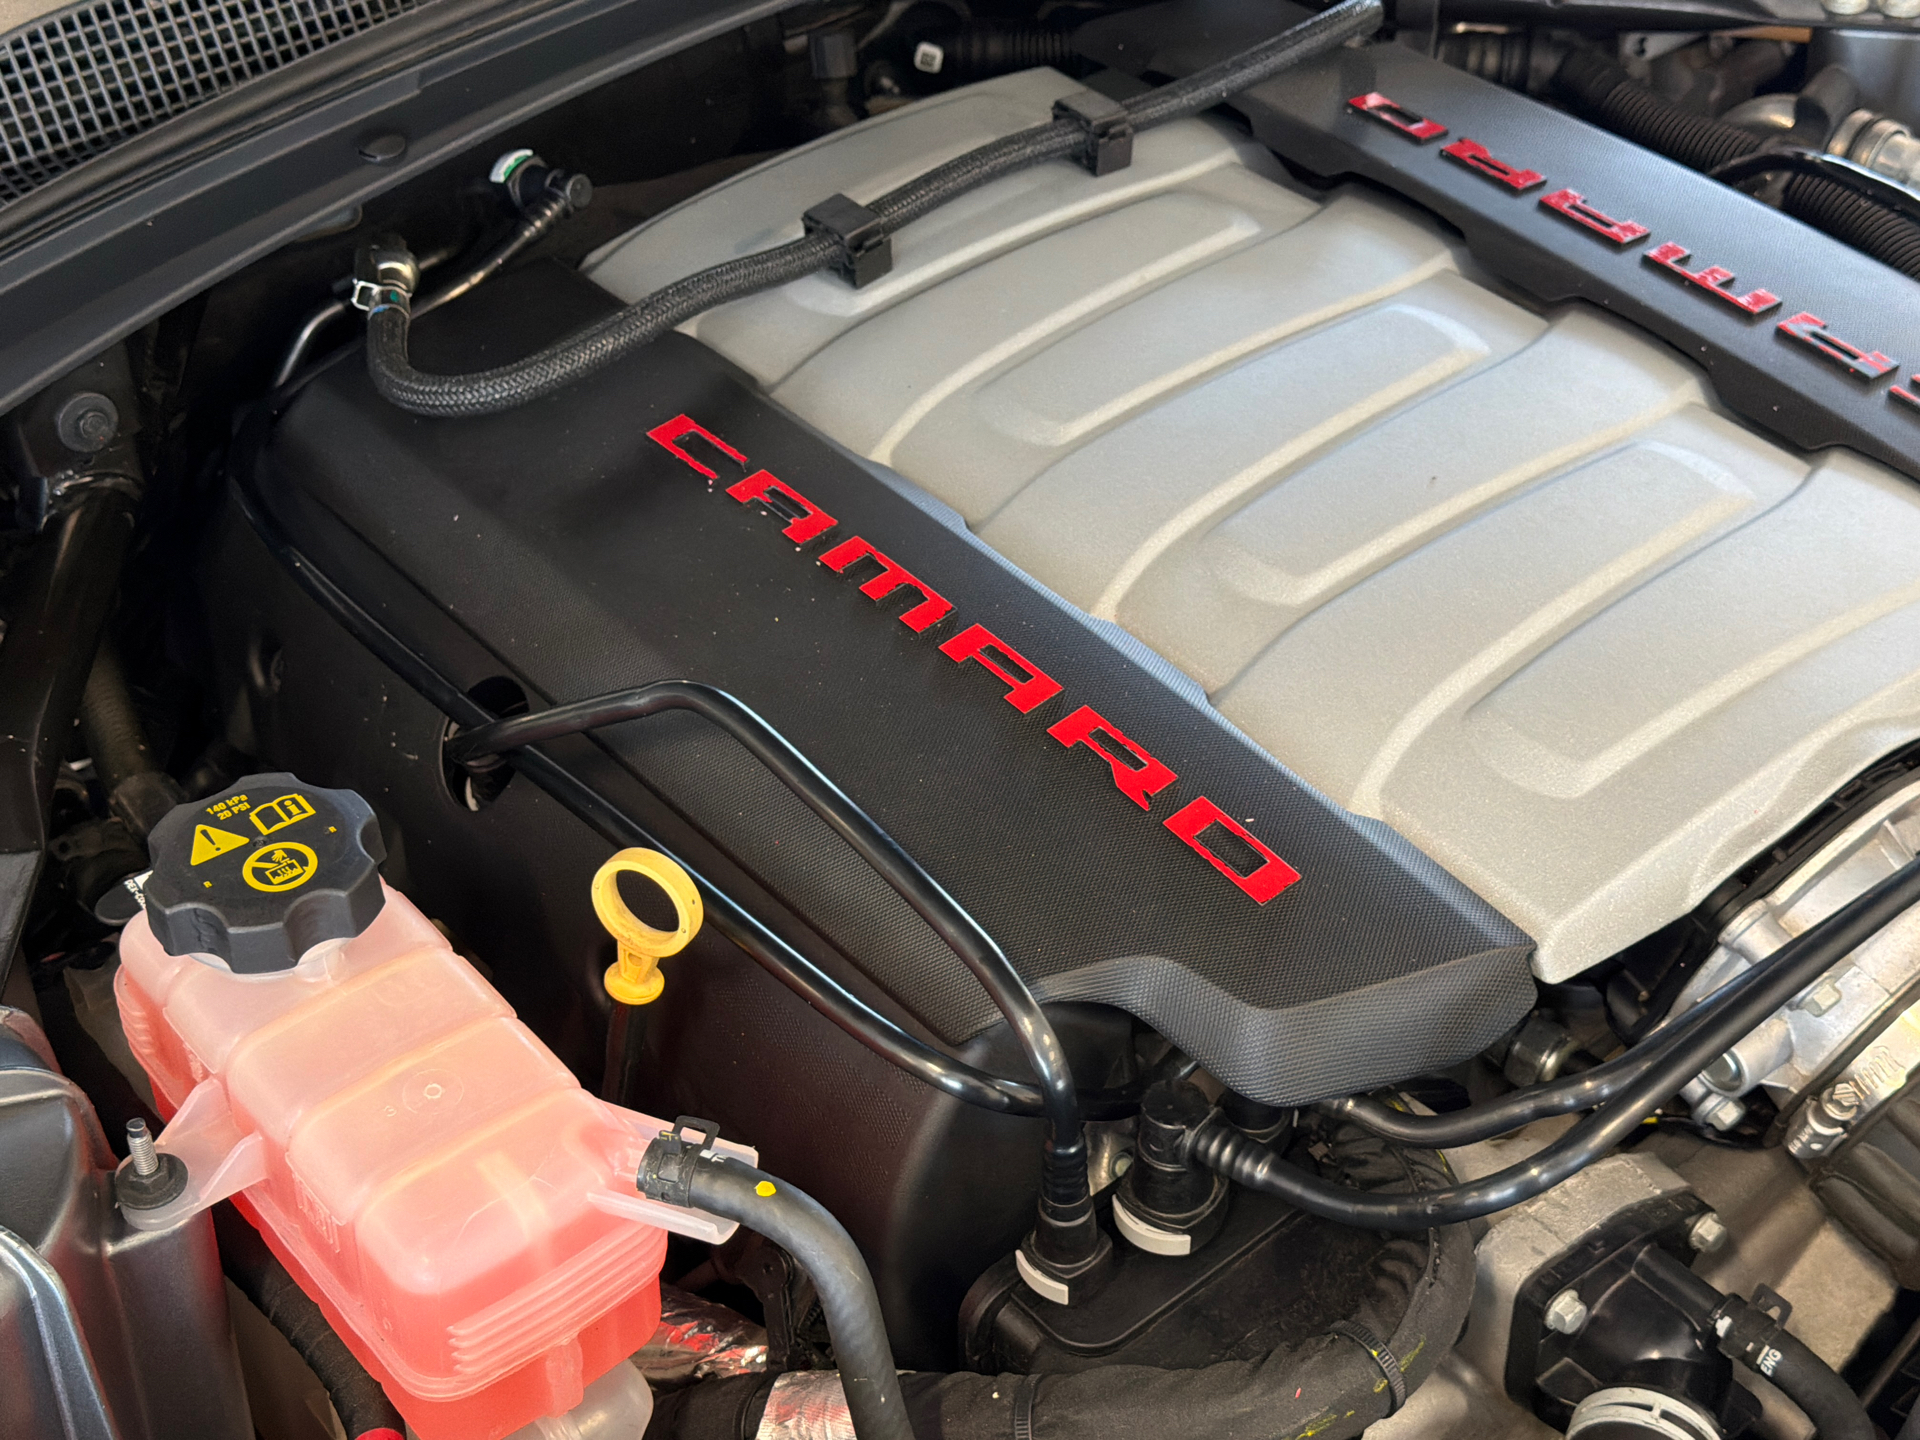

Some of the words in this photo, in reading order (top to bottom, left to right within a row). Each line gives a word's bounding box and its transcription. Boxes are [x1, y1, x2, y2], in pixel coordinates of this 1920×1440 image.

[1347, 91, 1920, 409] AMARO
[646, 412, 1301, 905] CAMARO
[205, 801, 227, 815] 140
[226, 794, 249, 806] kPa
[217, 810, 233, 820] 20
[231, 802, 251, 814] PSI
